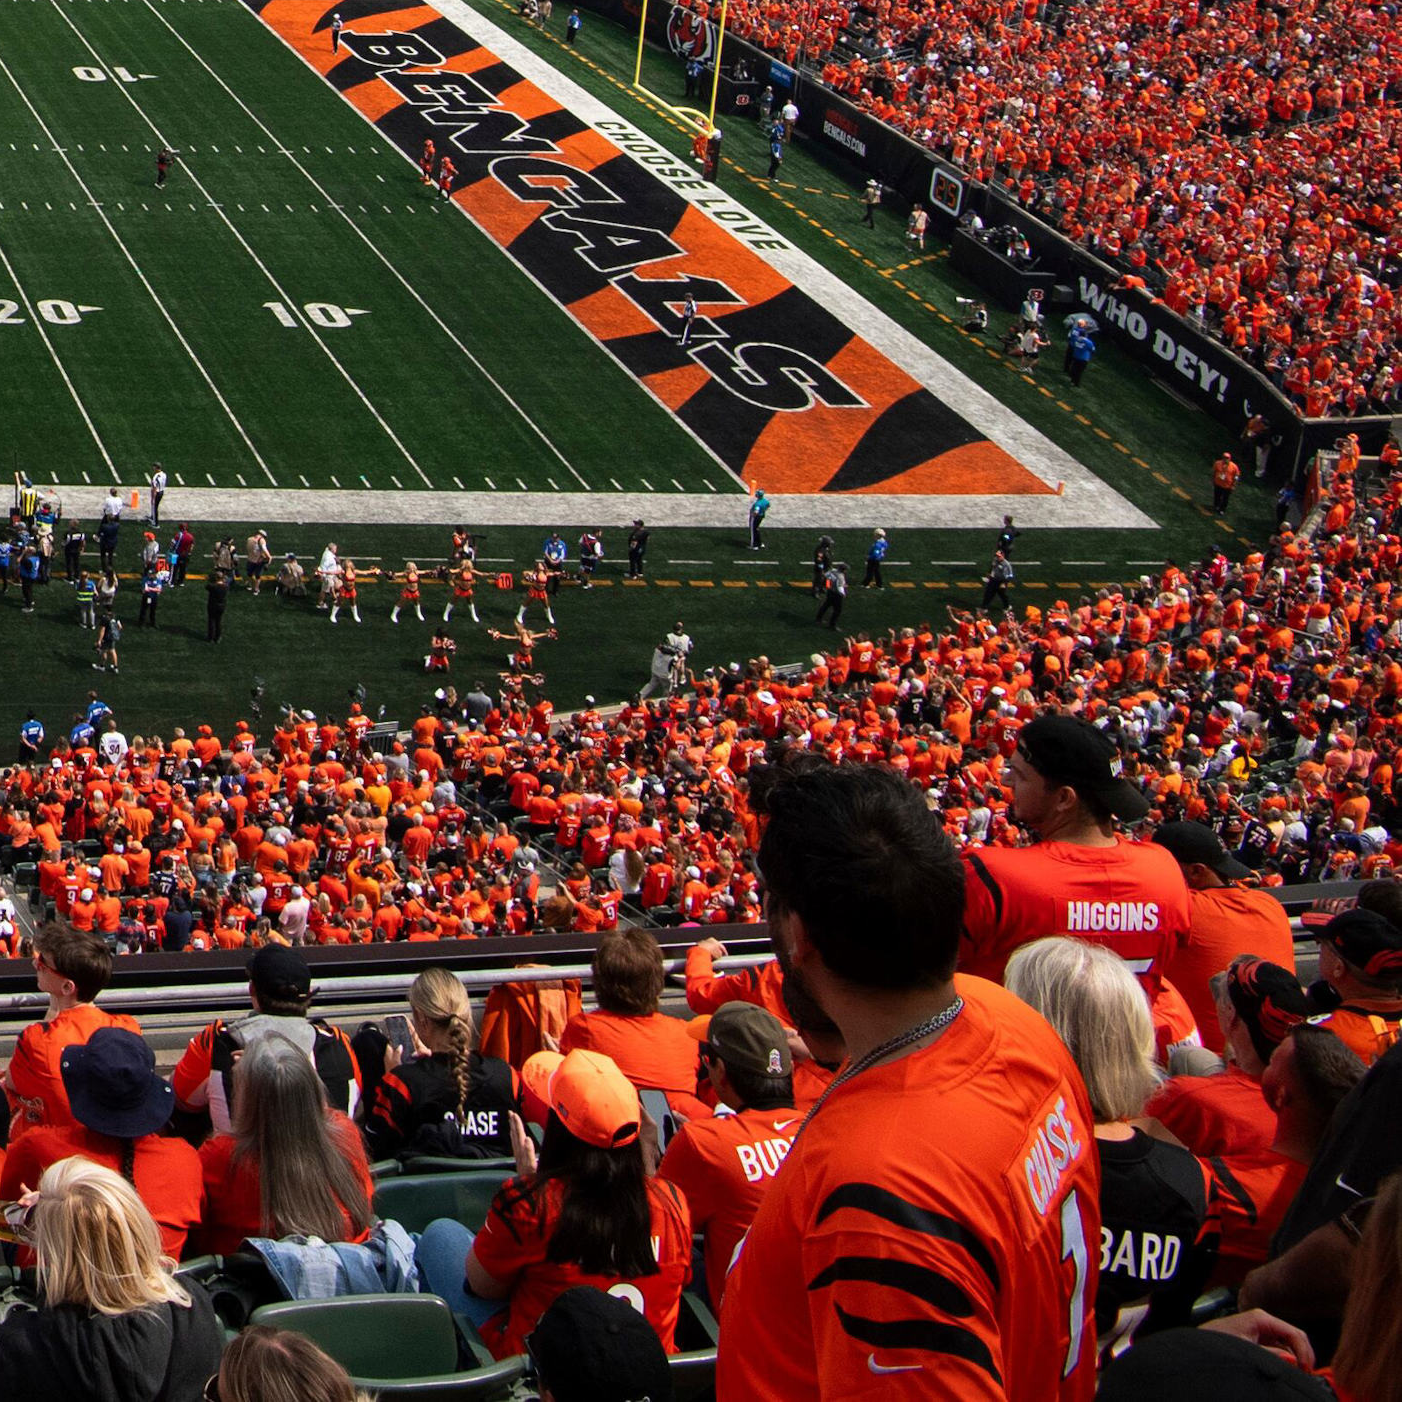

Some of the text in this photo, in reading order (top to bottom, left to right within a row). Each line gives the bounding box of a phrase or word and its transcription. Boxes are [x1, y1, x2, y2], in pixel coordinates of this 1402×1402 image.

[823, 120, 866, 158] BENGALS.COM
[340, 30, 872, 412] BENGALS
[594, 121, 790, 250] CHOOSE LOVE
[262, 301, 351, 328] 10
[1078, 276, 1229, 403] WHO DEY!
[1067, 900, 1159, 932] HIGGINS
[736, 1136, 795, 1183] BUR
[1023, 1096, 1080, 1216] CHASE
[1060, 1189, 1087, 1381] 1
[1099, 1225, 1182, 1281] BARD
